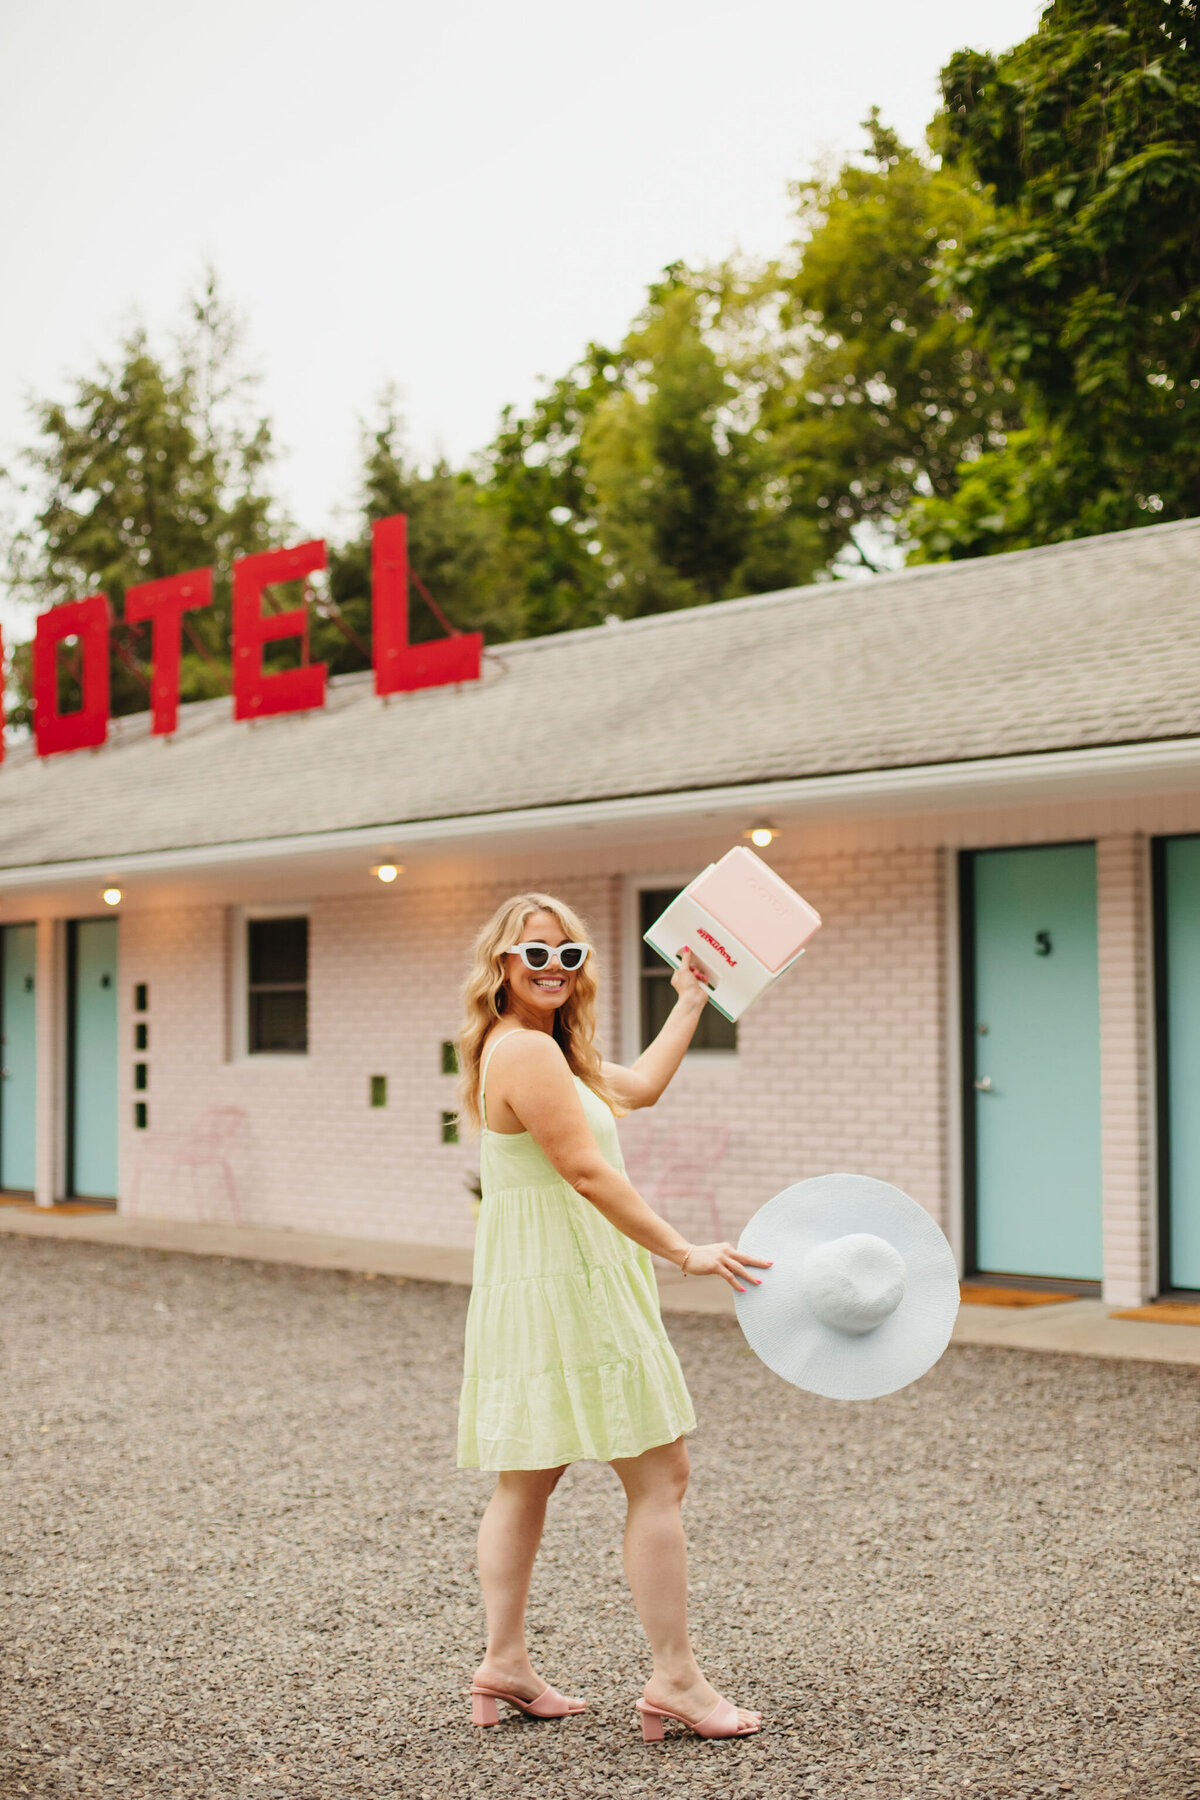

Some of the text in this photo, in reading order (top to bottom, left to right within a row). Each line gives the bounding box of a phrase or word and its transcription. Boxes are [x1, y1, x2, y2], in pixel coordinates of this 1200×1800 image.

[0, 514, 482, 764] OTEL
[697, 928, 737, 967] Playmate
[1035, 930, 1052, 956] 5
